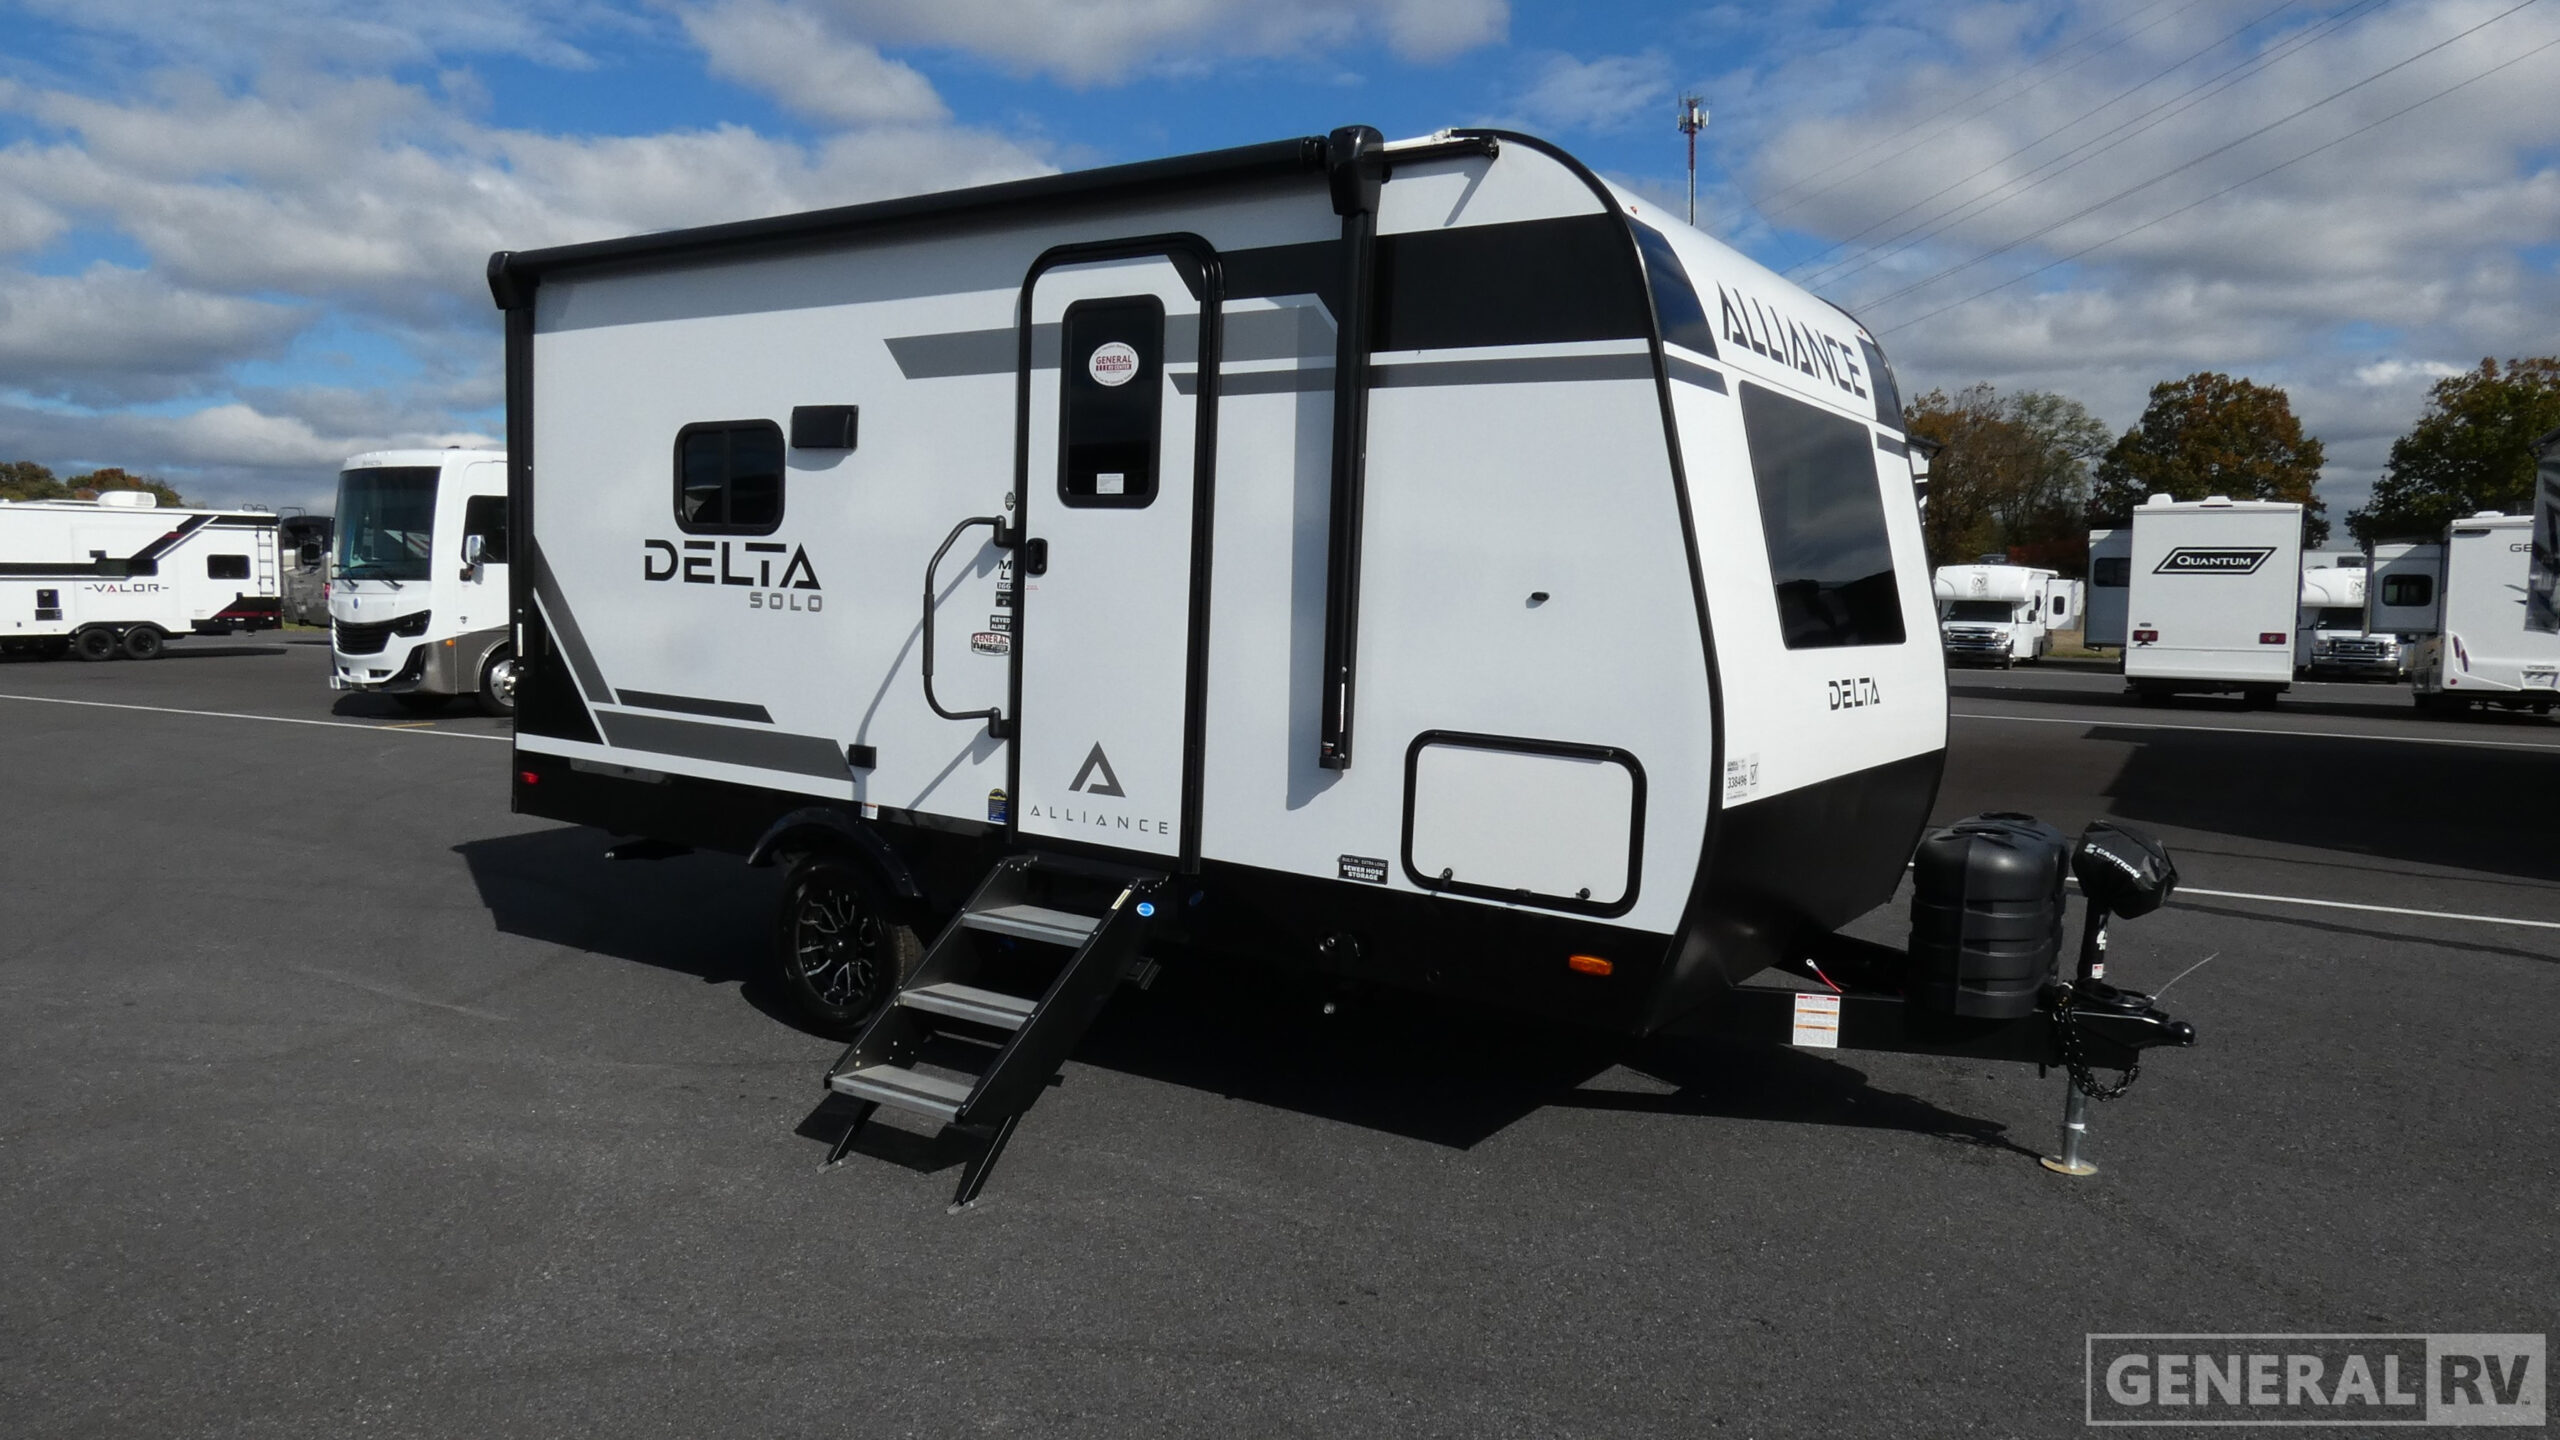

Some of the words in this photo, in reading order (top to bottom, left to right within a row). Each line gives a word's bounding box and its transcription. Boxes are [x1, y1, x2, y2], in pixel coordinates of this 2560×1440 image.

[1717, 281, 1868, 400] ALLIANCE
[1095, 355, 1132, 364] GENERAL
[2510, 544, 2533, 552] GE
[645, 539, 822, 590] DELTA
[750, 592, 822, 612] SOLO
[974, 634, 1009, 645] GENERAL
[1829, 677, 1880, 711] DELTA
[1030, 805, 1169, 835] ALLIANCE
[1343, 865, 1365, 873] SEWER
[1366, 868, 1384, 876] HOSE
[1348, 872, 1378, 880] STORAGE
